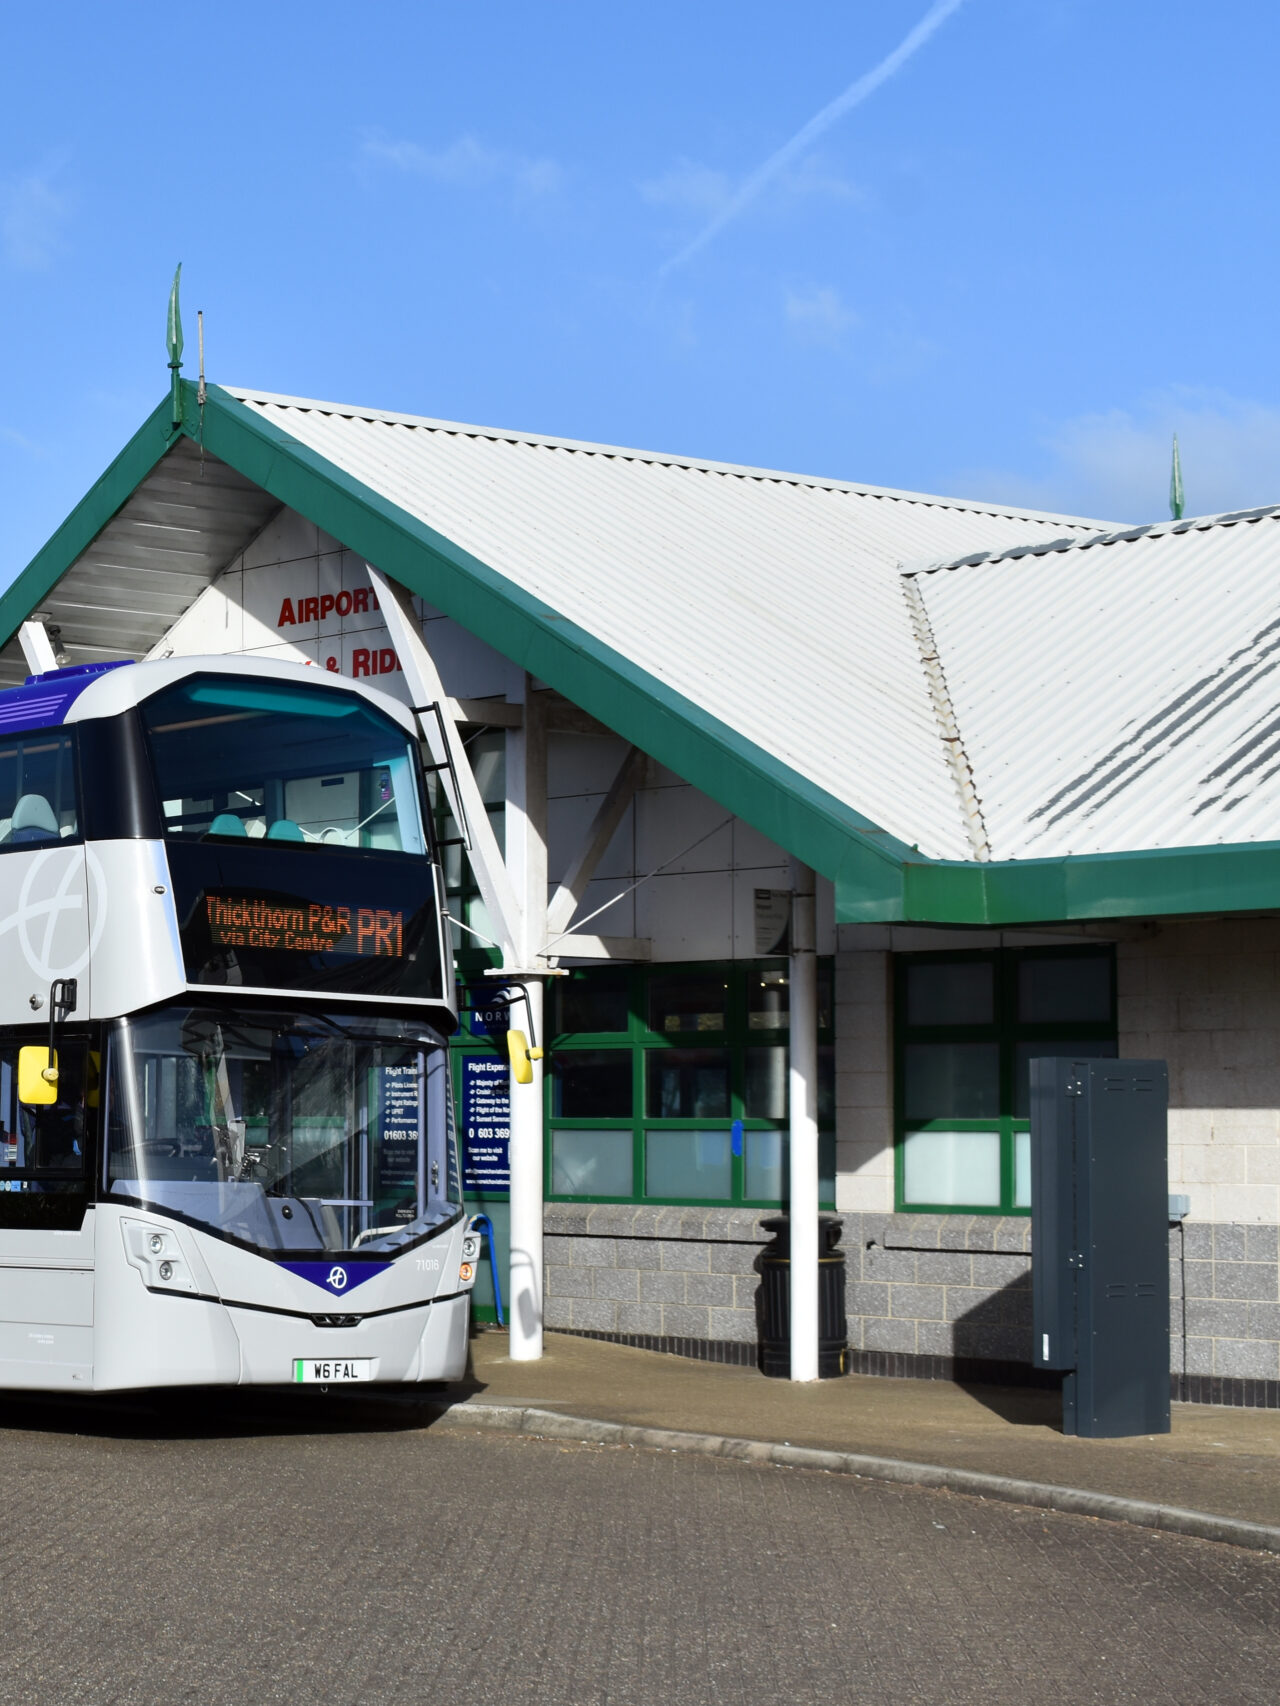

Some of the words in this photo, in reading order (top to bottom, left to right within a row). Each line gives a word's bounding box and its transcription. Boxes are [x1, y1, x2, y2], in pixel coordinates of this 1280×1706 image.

[353, 648, 403, 678] RID
[206, 896, 304, 931] Thickthorn
[308, 904, 352, 934] P&R
[221, 929, 245, 945] via
[249, 928, 280, 948] City
[284, 931, 334, 952] Centre
[357, 909, 403, 957] PR1
[385, 1067, 402, 1076] Flight
[468, 1063, 486, 1073] Flight
[384, 1130, 407, 1140] 01603
[407, 1130, 418, 1140] 36
[494, 1128, 510, 1138] 369
[416, 1258, 439, 1271] 71016
[314, 1363, 330, 1379] W6
[334, 1363, 358, 1379] FAL
